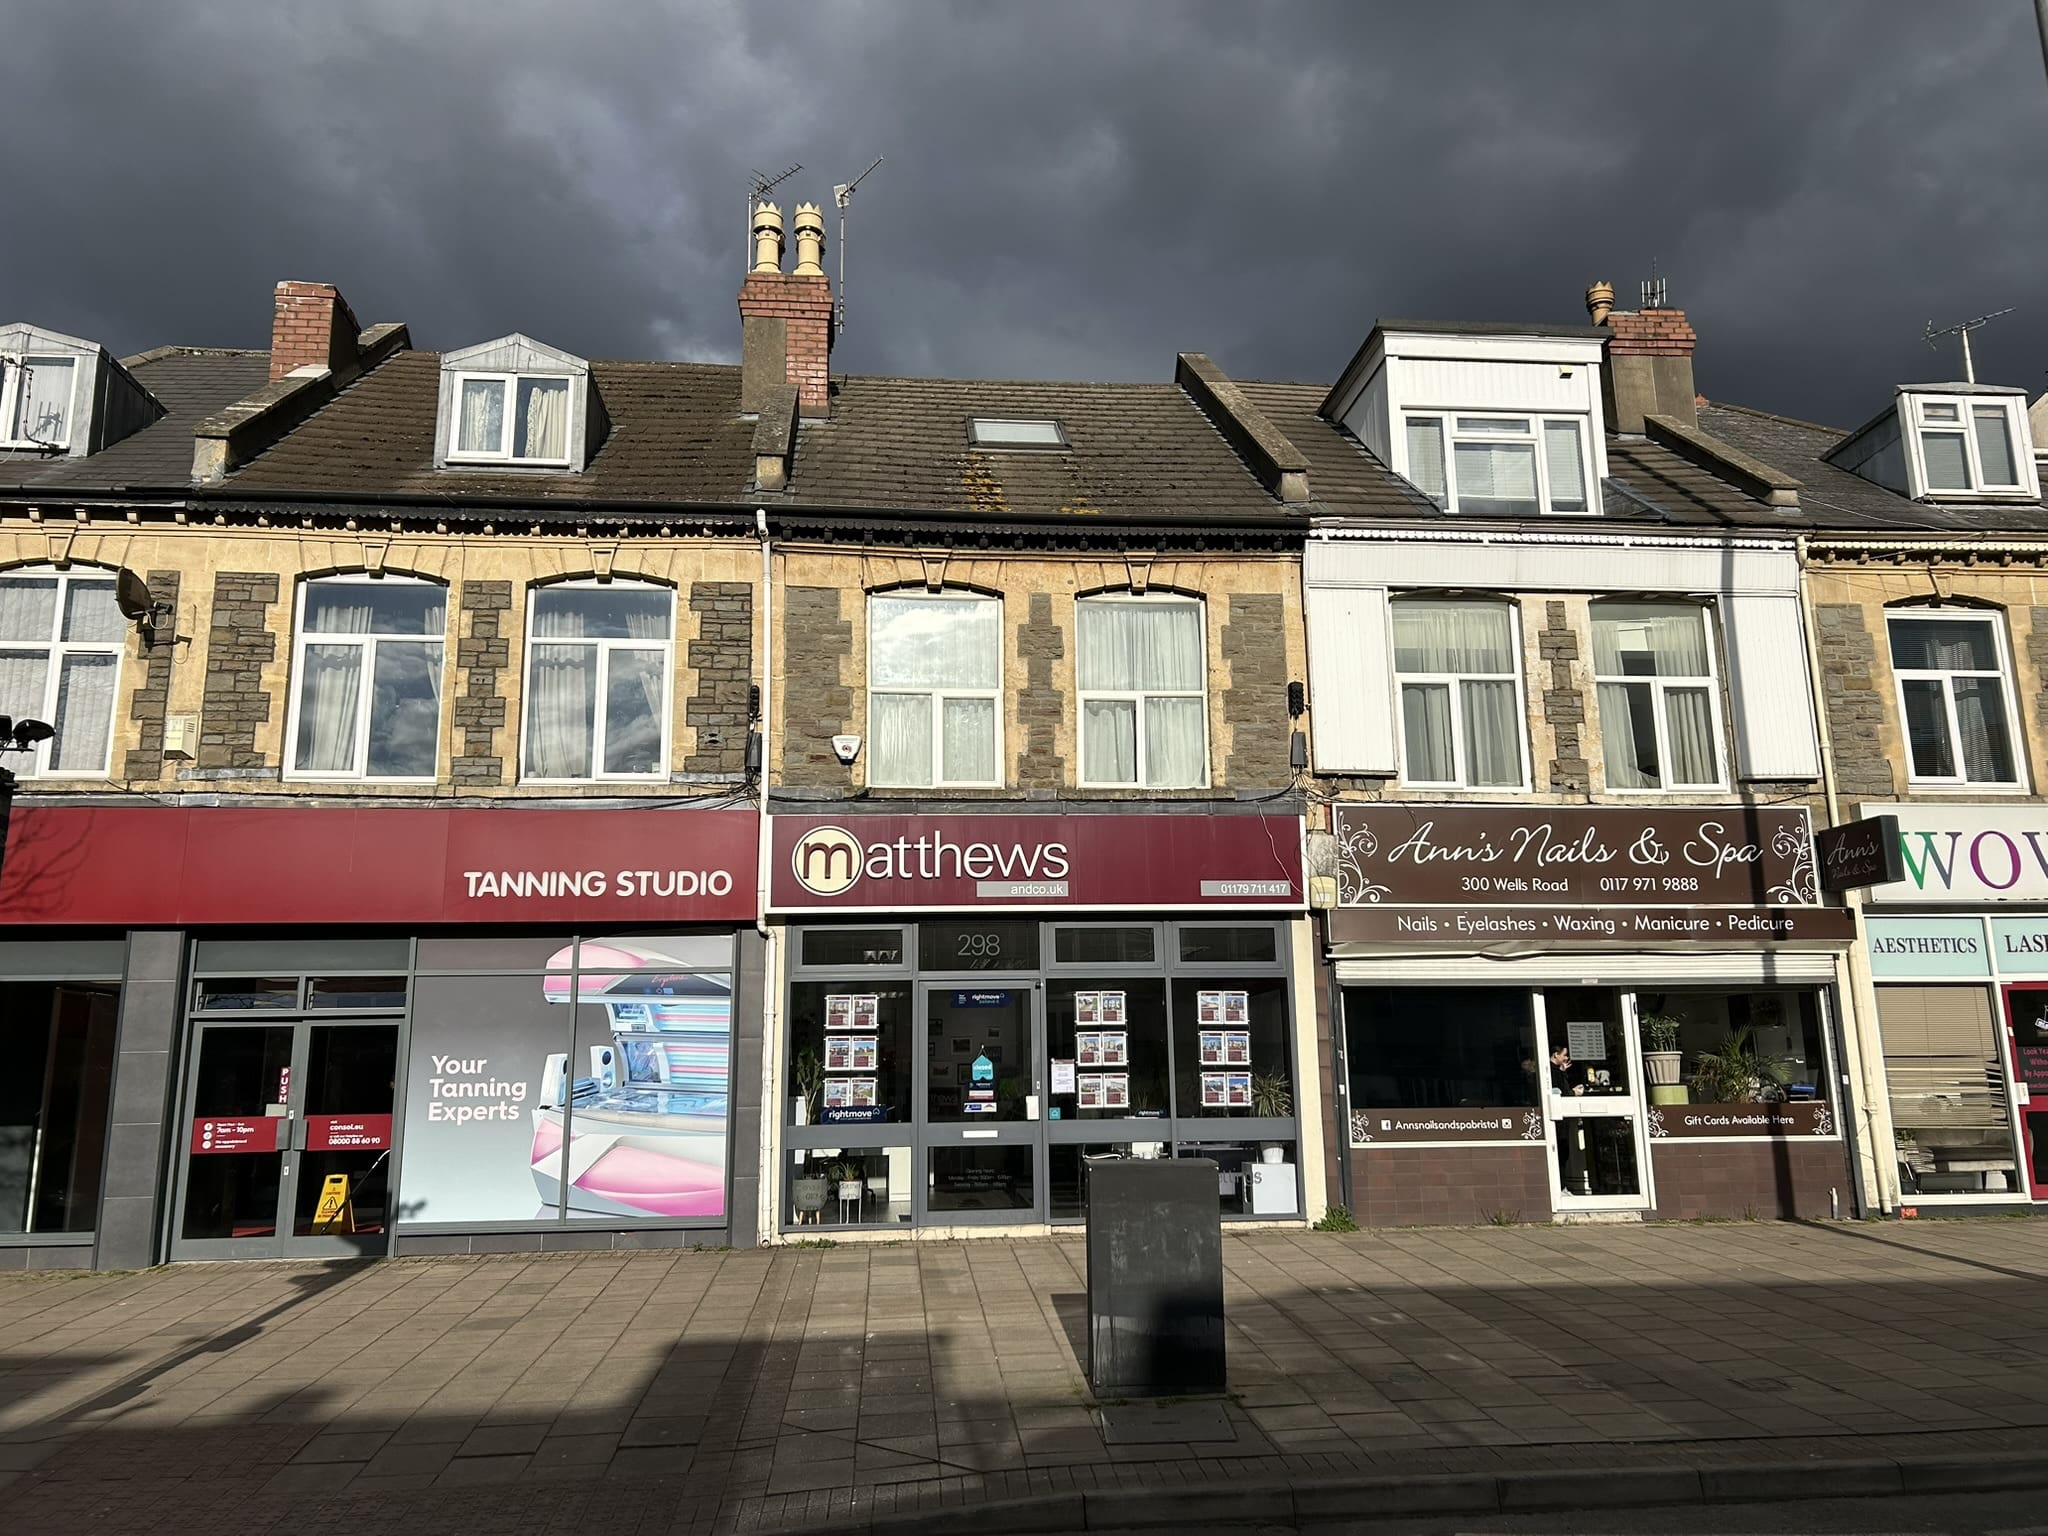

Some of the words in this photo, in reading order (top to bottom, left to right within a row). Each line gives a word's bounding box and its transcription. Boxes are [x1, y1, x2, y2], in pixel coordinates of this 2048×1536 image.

[802, 830, 1070, 880] matthews
[1387, 820, 1504, 865] Ann's
[1509, 823, 1618, 867] Nails
[1628, 826, 1670, 866] &
[1682, 821, 1764, 879] Spa
[1826, 832, 1880, 866] Ann's
[463, 870, 607, 898] TANNING
[615, 869, 733, 897] STUDIO
[1010, 883, 1064, 895] andco.uk
[1220, 883, 1249, 894] 01179
[1250, 883, 1267, 894] 711
[1268, 883, 1287, 894] 417
[1461, 876, 1490, 891] 300
[1492, 876, 1529, 892] Wells
[1532, 876, 1569, 892] Road
[1600, 876, 1628, 891] 0117
[1632, 876, 1657, 891] 971
[1662, 876, 1699, 891] 9888
[1397, 914, 1438, 932] Nails
[1456, 914, 1537, 935] Eyelashes
[1553, 914, 1616, 935] Waxing
[1634, 914, 1710, 931] Manicure
[1728, 914, 1795, 932] Pedicure
[956, 933, 1001, 957] 298
[1873, 937, 1978, 954] AESTHETICS
[431, 1055, 488, 1075] Your
[279, 1067, 290, 1104] PUSH
[429, 1077, 527, 1102] Tanning
[428, 1101, 520, 1126] Experts
[828, 1110, 873, 1120] rightmove
[1684, 1114, 1702, 1126] Gift
[1703, 1114, 1730, 1125] Cards
[1731, 1114, 1770, 1125] Available
[1772, 1114, 1795, 1125] Here
[216, 1126, 231, 1134] 7am
[236, 1126, 255, 1135] 10pm
[1395, 1118, 1499, 1131] Annsnailsandspabristol
